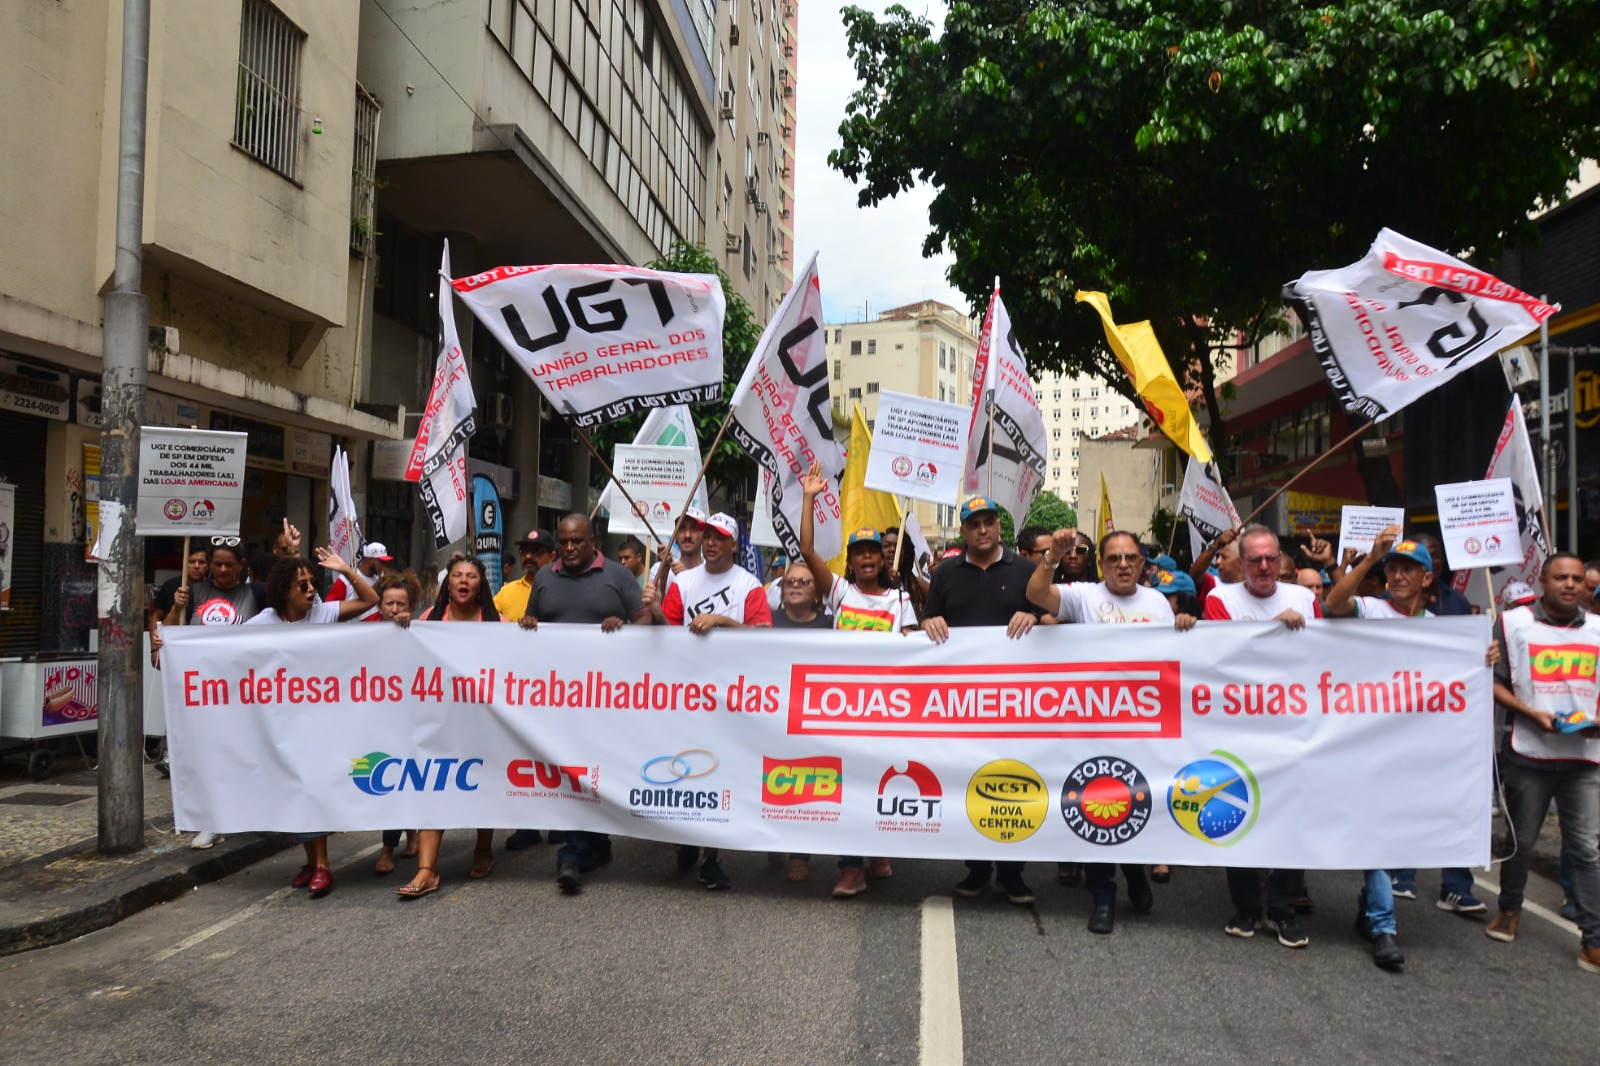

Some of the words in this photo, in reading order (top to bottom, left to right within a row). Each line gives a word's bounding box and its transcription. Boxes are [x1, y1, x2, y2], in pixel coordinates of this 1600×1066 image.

[465, 269, 500, 286] UGT
[500, 278, 674, 352] UGT
[531, 351, 588, 377] UNIÃO
[597, 339, 661, 358] GERAL
[668, 328, 706, 346] DOS
[544, 347, 709, 391] TRABALHADORES
[14, 396, 60, 415] 2224-0005
[607, 399, 635, 418] UGT
[639, 394, 667, 408] UGT
[671, 388, 702, 403] UGT
[174, 445, 235, 454] COMERCIÁRIOS
[734, 426, 760, 455] UGT
[782, 413, 818, 466] GERA
[1001, 418, 1020, 443] UGT
[1017, 439, 1036, 465] UGT
[149, 470, 216, 478] TRABALHADORES
[188, 480, 238, 488] AMERICANAS
[193, 509, 213, 517] UGT
[432, 516, 445, 538] UGT
[1534, 648, 1597, 677] CTB
[46, 667, 97, 690] HOT
[184, 671, 229, 707] Em
[239, 668, 340, 704] defesa
[350, 666, 403, 702] dos
[410, 666, 443, 702] 44
[452, 668, 495, 704] mil
[504, 670, 717, 711] trabalhadores
[726, 674, 780, 714] das
[802, 687, 911, 718] LOJAS
[921, 686, 1161, 718] AMERICANAS
[1192, 683, 1211, 716] e
[1223, 682, 1308, 716] suas
[1317, 671, 1467, 714] famílias
[371, 758, 484, 792] CNTC
[506, 759, 588, 793] CUT
[591, 764, 600, 798] BRASIL
[766, 765, 839, 797] CTB
[1072, 758, 1138, 787] FORÇA
[505, 790, 530, 798] CENTRAL
[629, 788, 719, 810] contracs
[985, 782, 1030, 793] NCST
[877, 795, 941, 820] UGT
[990, 806, 1023, 816] NOVA
[1172, 800, 1200, 813] CSB
[875, 819, 898, 827] UNIÃO
[877, 826, 940, 834] TRABALHADORES
[979, 818, 1035, 829] CENTRAL
[1063, 806, 1150, 844] SINDICAL
[1000, 831, 1014, 840] SP
